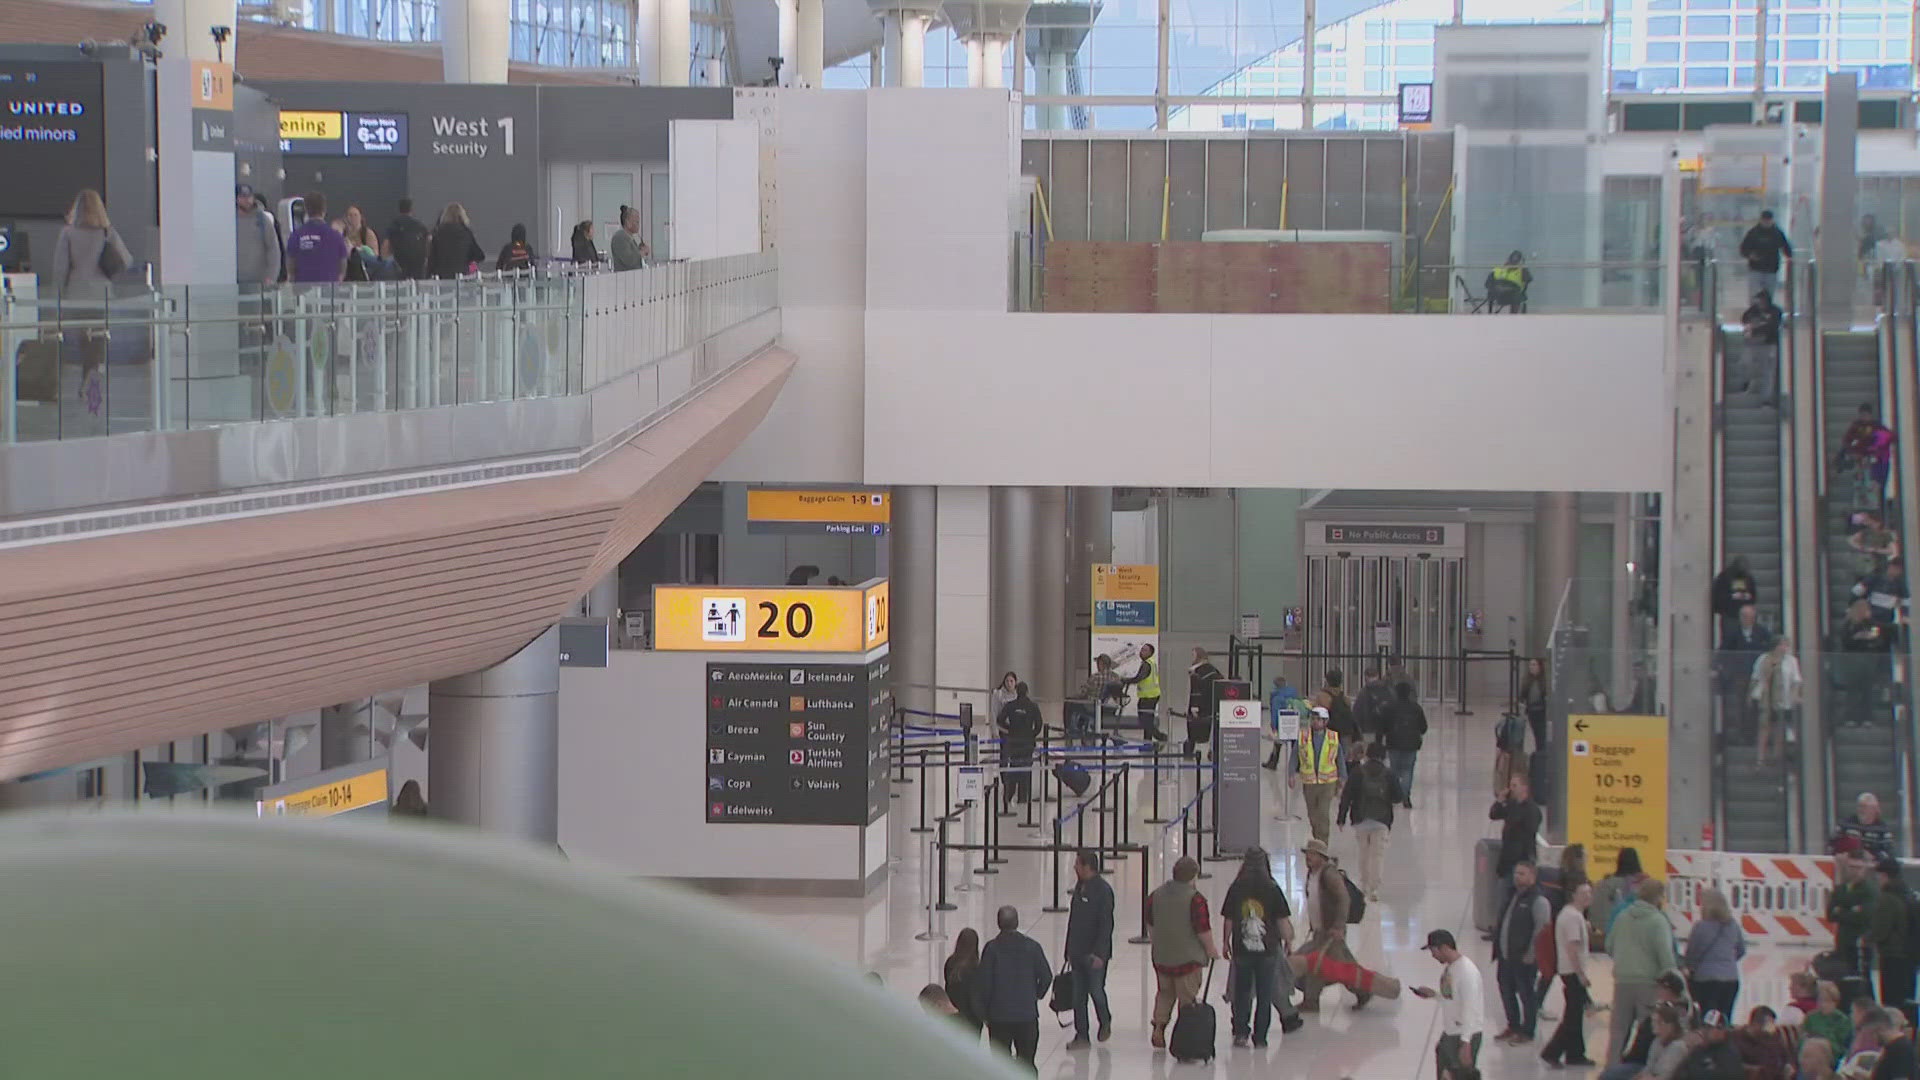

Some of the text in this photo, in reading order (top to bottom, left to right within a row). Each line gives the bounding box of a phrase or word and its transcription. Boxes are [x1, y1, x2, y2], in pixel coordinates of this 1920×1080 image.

[9, 101, 84, 115] UNITED
[432, 116, 488, 136] West
[25, 126, 77, 141] minors
[357, 127, 399, 143] 6-10
[497, 117, 514, 155] 1
[432, 141, 488, 158] Security
[798, 494, 867, 505] Baggage Claim 1-9
[826, 525, 850, 534] Parking
[1349, 529, 1421, 540] No Public Access
[757, 601, 813, 638] 20
[876, 596, 886, 635] 20
[727, 671, 784, 682] AeroMexico
[808, 672, 855, 682] Icelandair
[727, 698, 779, 708] Air Canada
[807, 699, 854, 709] Lufthansa
[727, 725, 760, 735] Breeze
[807, 721, 825, 731] Sun
[807, 733, 845, 744] Country
[807, 749, 842, 758] Turkish
[1593, 745, 1636, 756] Baggage
[727, 751, 766, 763] Cayman
[1593, 758, 1622, 767] Claim
[807, 759, 843, 768] Airlines
[727, 779, 751, 790] Copa
[807, 780, 841, 789] Volaris
[1595, 774, 1642, 788] 10-19
[328, 784, 352, 808] 10-14
[1609, 796, 1643, 804] Canada
[727, 805, 773, 815] Edelweiss
